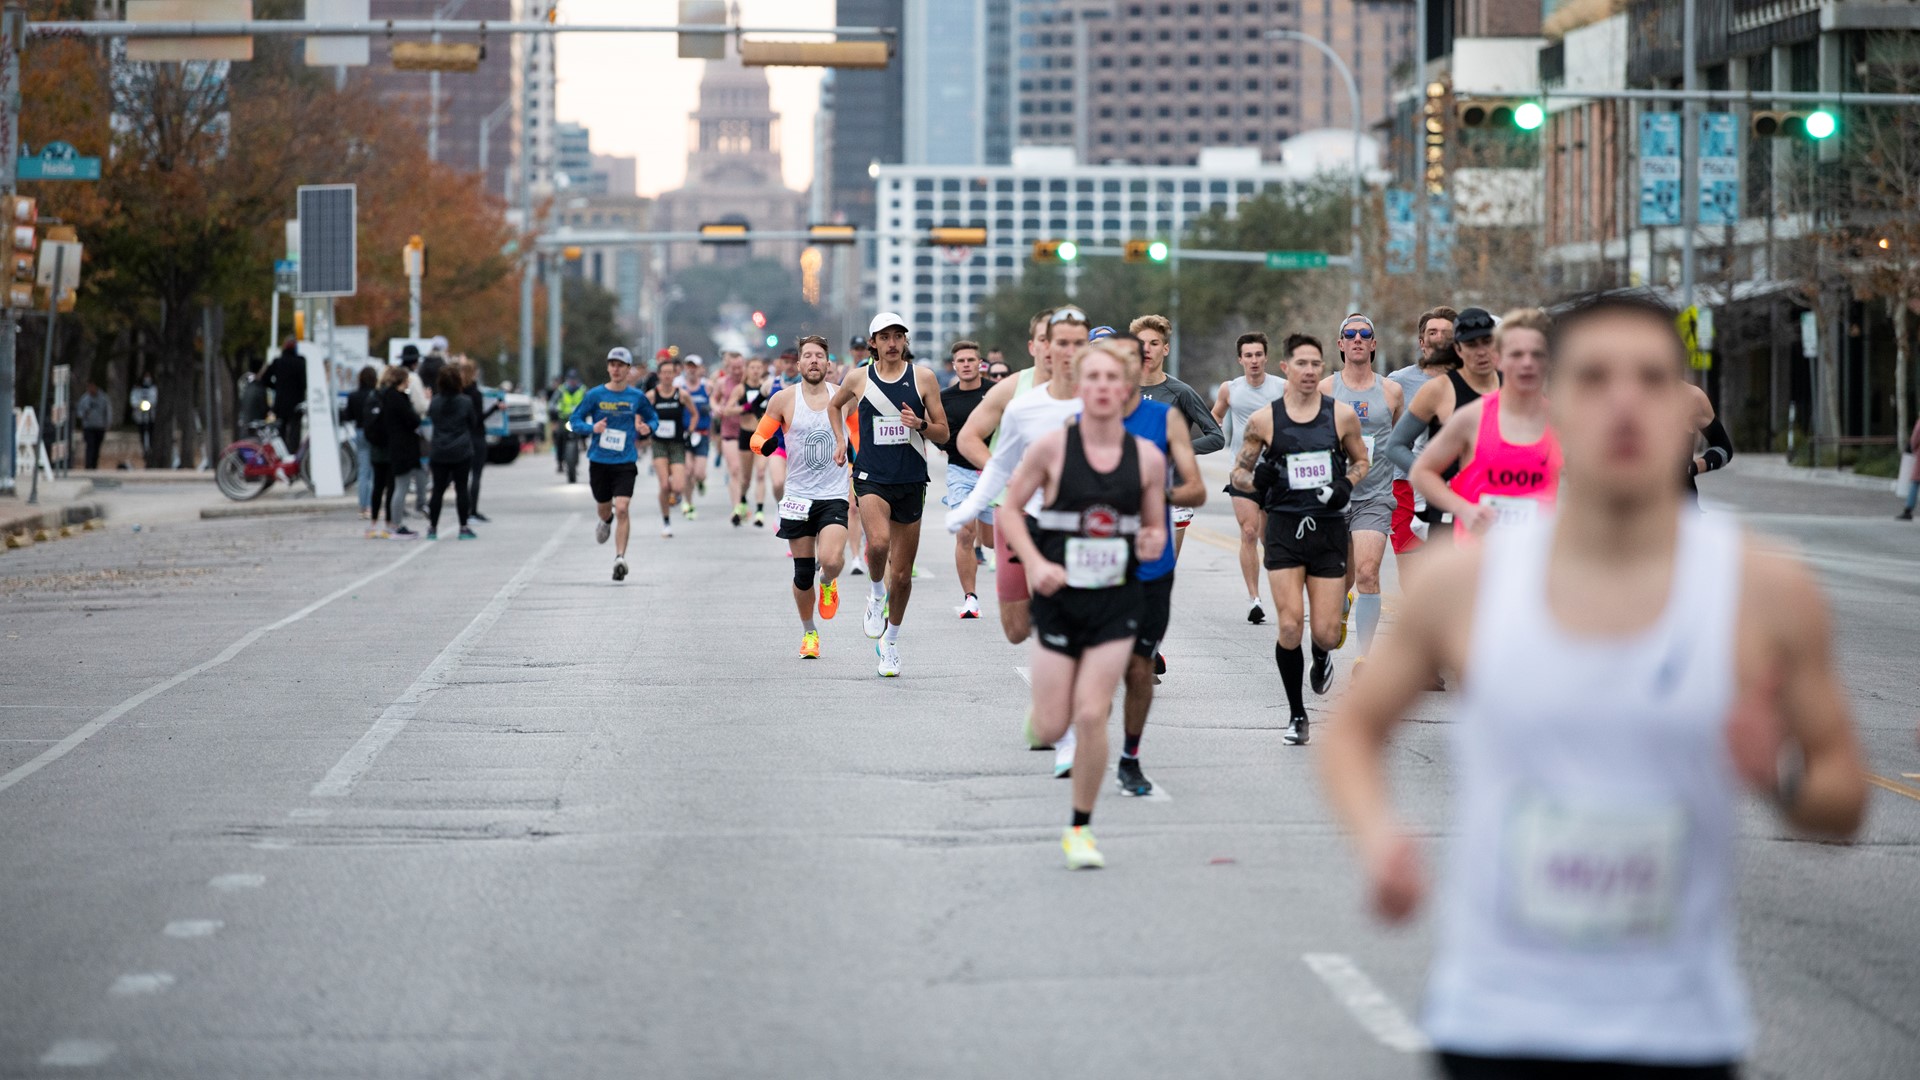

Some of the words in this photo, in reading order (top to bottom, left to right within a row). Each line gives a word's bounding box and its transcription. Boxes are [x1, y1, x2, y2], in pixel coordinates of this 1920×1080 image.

[879, 425, 905, 437] 17619
[1294, 464, 1326, 479] 18389
[1487, 469, 1544, 487] LOOP
